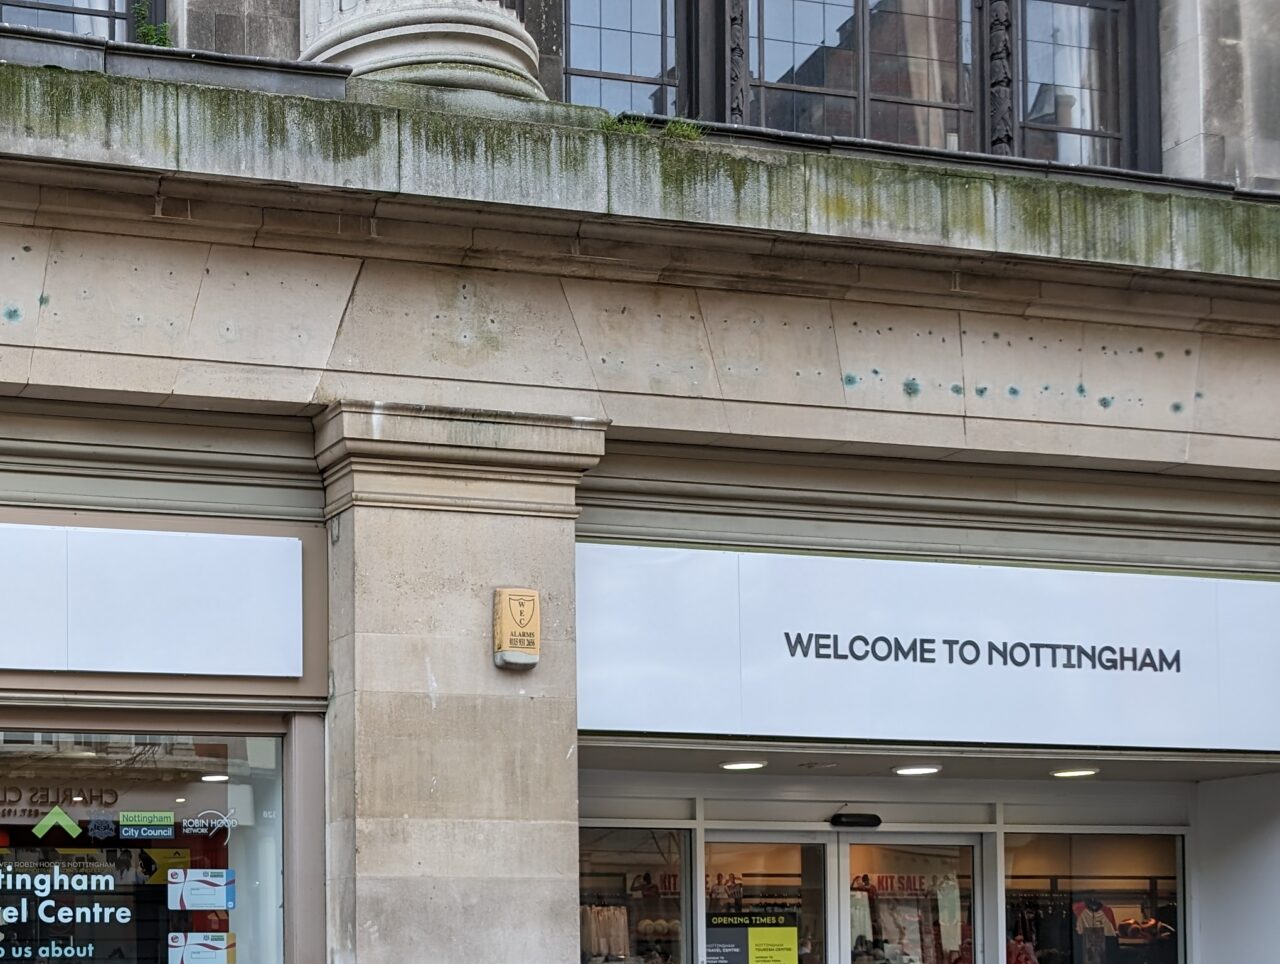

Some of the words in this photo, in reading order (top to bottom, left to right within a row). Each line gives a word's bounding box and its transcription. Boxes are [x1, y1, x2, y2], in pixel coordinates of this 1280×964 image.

[783, 632, 937, 664] WELCOME
[942, 639, 981, 665] TO
[988, 641, 1181, 673] NOTTINGHAM
[122, 813, 172, 825] Nottingham
[182, 818, 209, 828] ROBIN
[210, 818, 238, 828] HOOD
[122, 827, 140, 838] City
[141, 827, 172, 836] Council
[877, 875, 897, 891] KIT
[899, 875, 926, 892] SALE
[37, 899, 132, 924] Centre
[711, 916, 750, 924] OPENING
[752, 916, 777, 924] TIMES
[11, 946, 33, 958] us
[38, 940, 95, 958] about
